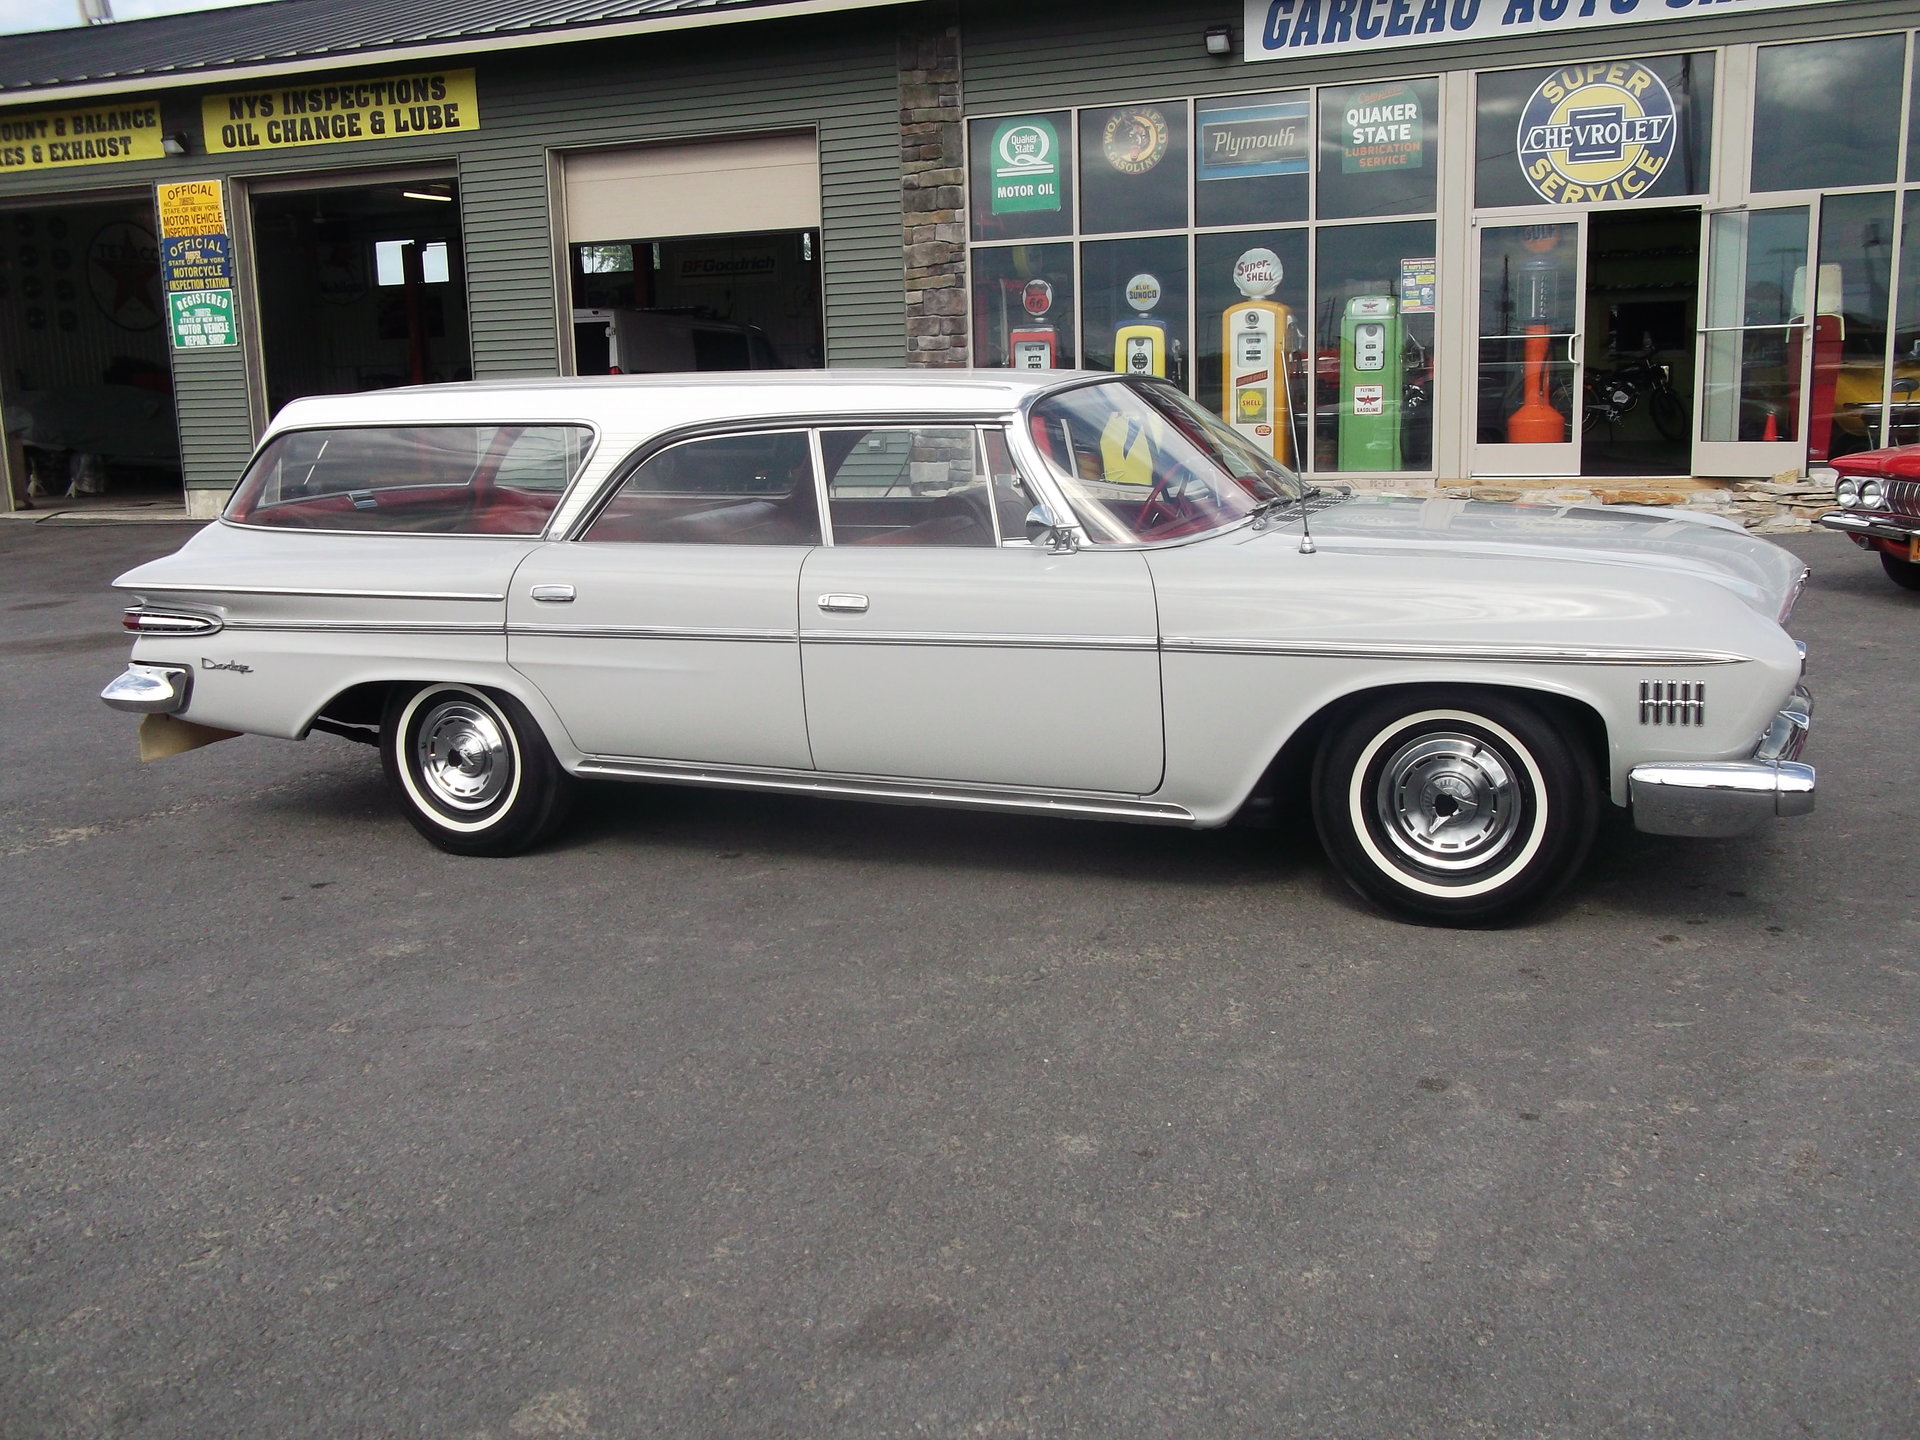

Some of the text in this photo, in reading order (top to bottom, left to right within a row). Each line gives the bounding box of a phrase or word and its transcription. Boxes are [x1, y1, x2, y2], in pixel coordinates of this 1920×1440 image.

[1262, 0, 1482, 50] GARCEAU
[1542, 62, 1652, 105] SUPER
[229, 76, 446, 121] NYS INSPECTIONS
[1346, 103, 1417, 128] QUAKER
[0, 108, 157, 142] OUNT & BALANCE
[222, 103, 460, 149] OIL CHANGE & LUBE
[1011, 134, 1038, 145] Quaker
[1212, 126, 1296, 157] Plymouth
[1352, 123, 1411, 145] STATE
[1530, 119, 1663, 150] CHEVROLET
[32, 144, 43, 163] &
[49, 136, 132, 162] EXHAUST
[1015, 144, 1035, 154] State
[1344, 141, 1420, 157] LUBRICATION
[1109, 151, 1160, 172] GASOLINE
[1359, 154, 1407, 167] SERVICE
[1528, 149, 1664, 204] SERVICE
[167, 184, 213, 200] OFFICIAL
[997, 183, 1055, 198] MOTOR OIL
[163, 212, 223, 226] MOTOR VEHICLE
[164, 224, 224, 237] INSPECTION STATION
[170, 238, 223, 257] OFFICIAL
[173, 265, 223, 278] MOTORCYCLE
[682, 255, 776, 273] BFGoodrich
[169, 277, 230, 291] INSPECTION STATION
[1246, 272, 1274, 282] SHELL
[176, 292, 228, 311] REGISTERED
[1029, 298, 1043, 308] 66
[1129, 290, 1157, 300] SUNOCO
[178, 322, 230, 335] MOTOR VEHICLE
[184, 334, 226, 346] REPAIR SHOP
